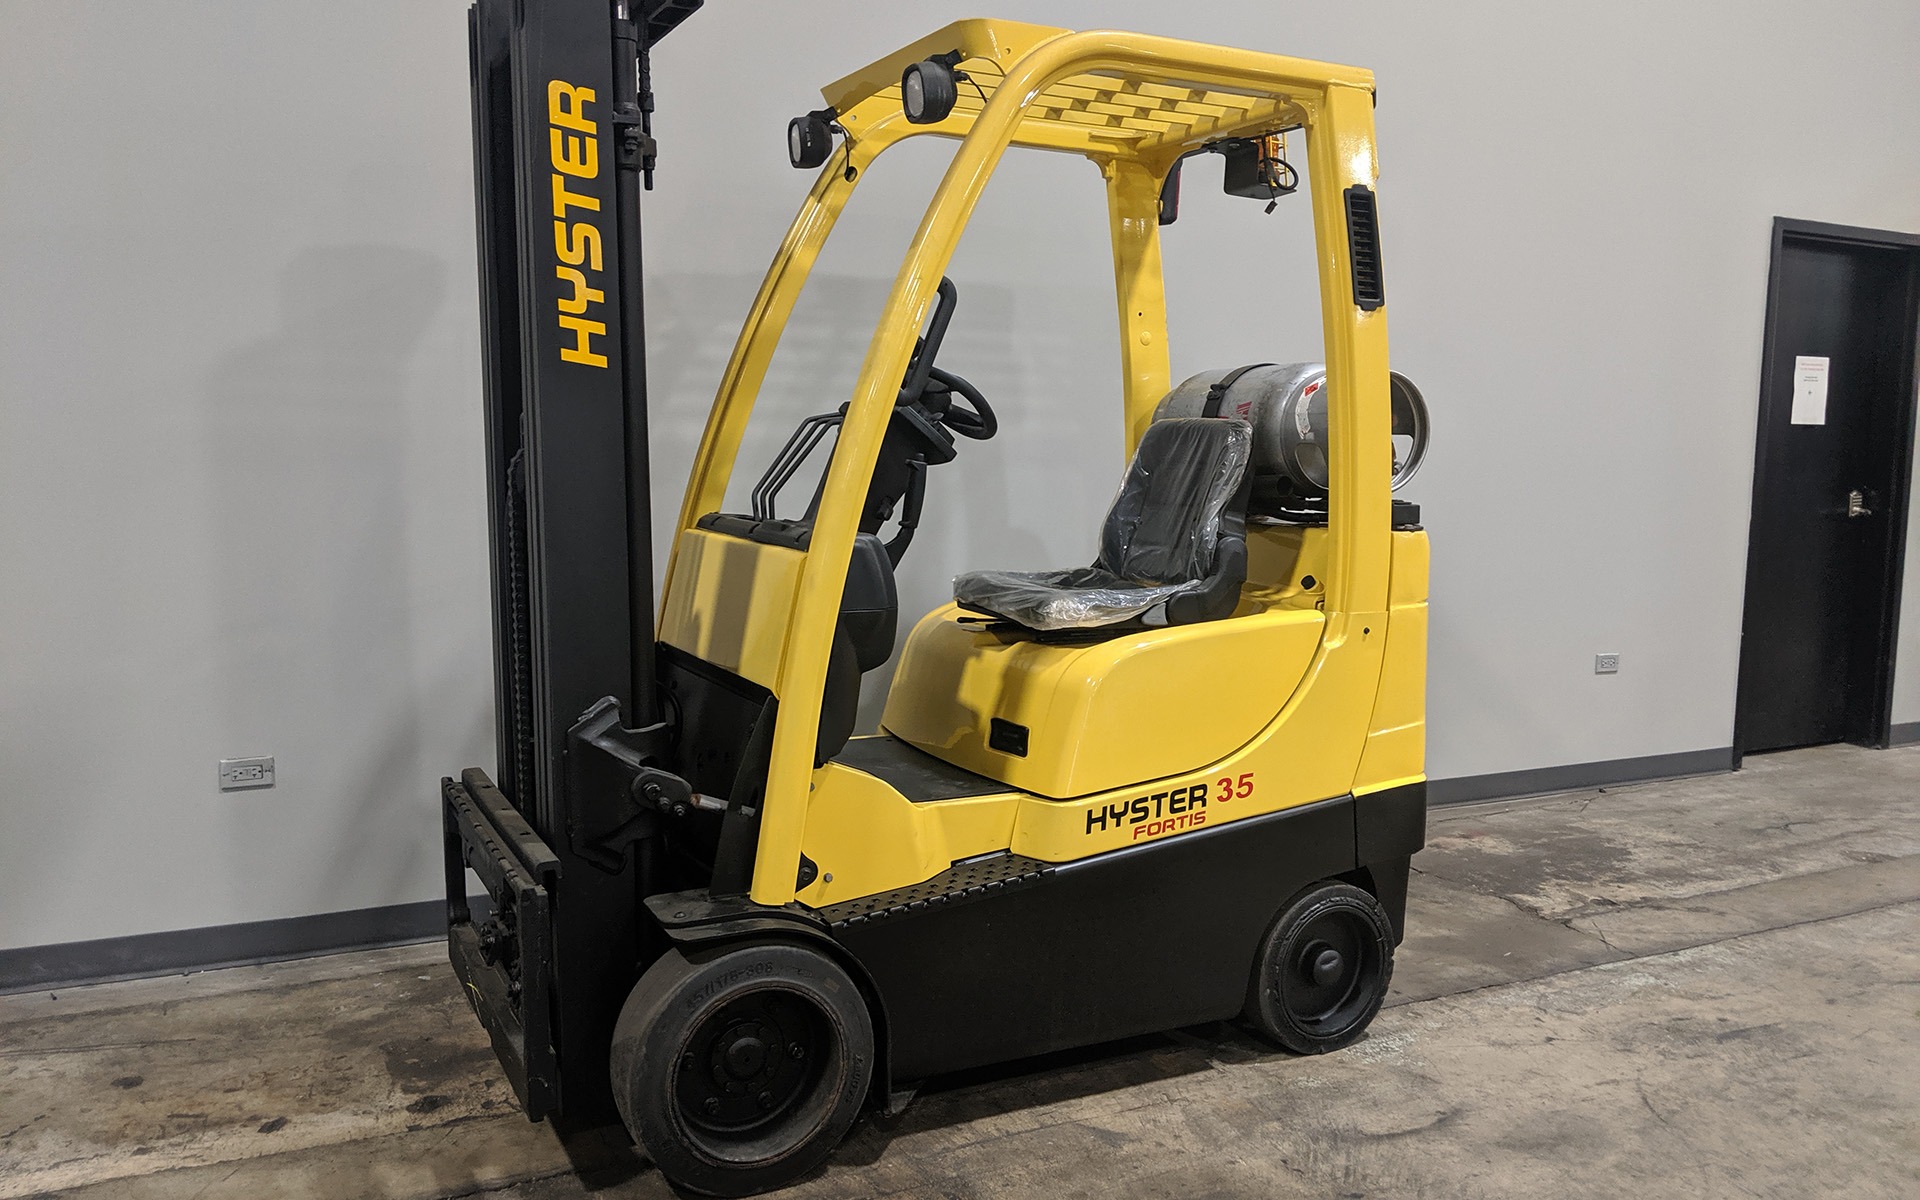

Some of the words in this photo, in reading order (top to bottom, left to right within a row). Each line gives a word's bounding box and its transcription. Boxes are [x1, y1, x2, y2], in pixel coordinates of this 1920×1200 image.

[548, 79, 608, 369] HYSTER
[1085, 783, 1208, 835] HYSTER
[1216, 772, 1254, 802] 35
[1133, 810, 1206, 840] FORTIS
